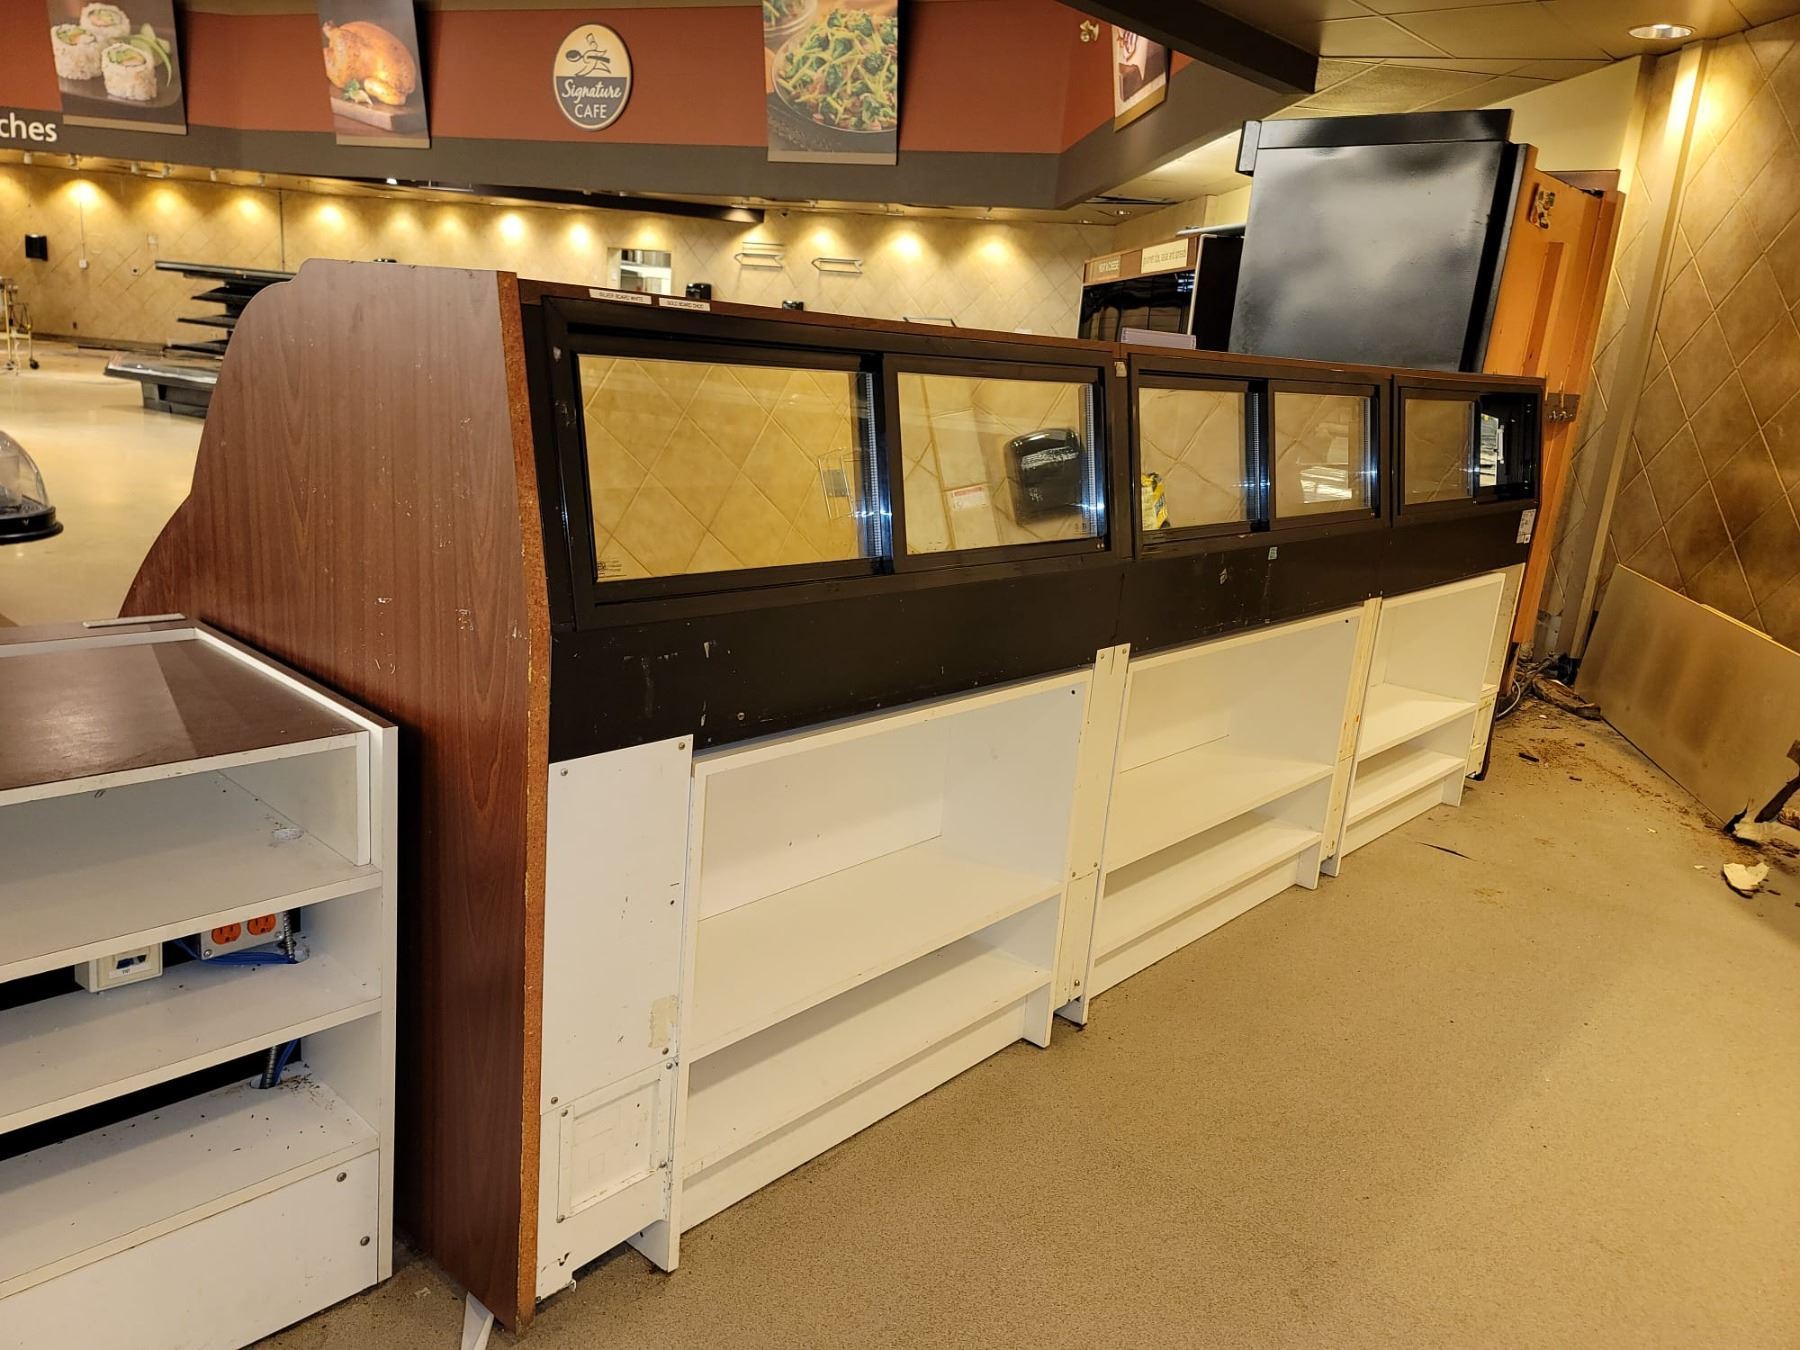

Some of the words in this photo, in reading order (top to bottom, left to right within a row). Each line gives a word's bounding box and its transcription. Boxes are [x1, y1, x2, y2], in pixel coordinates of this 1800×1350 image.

[562, 79, 622, 104] Signature
[574, 104, 608, 119] CAFE
[0, 112, 58, 142] ches
